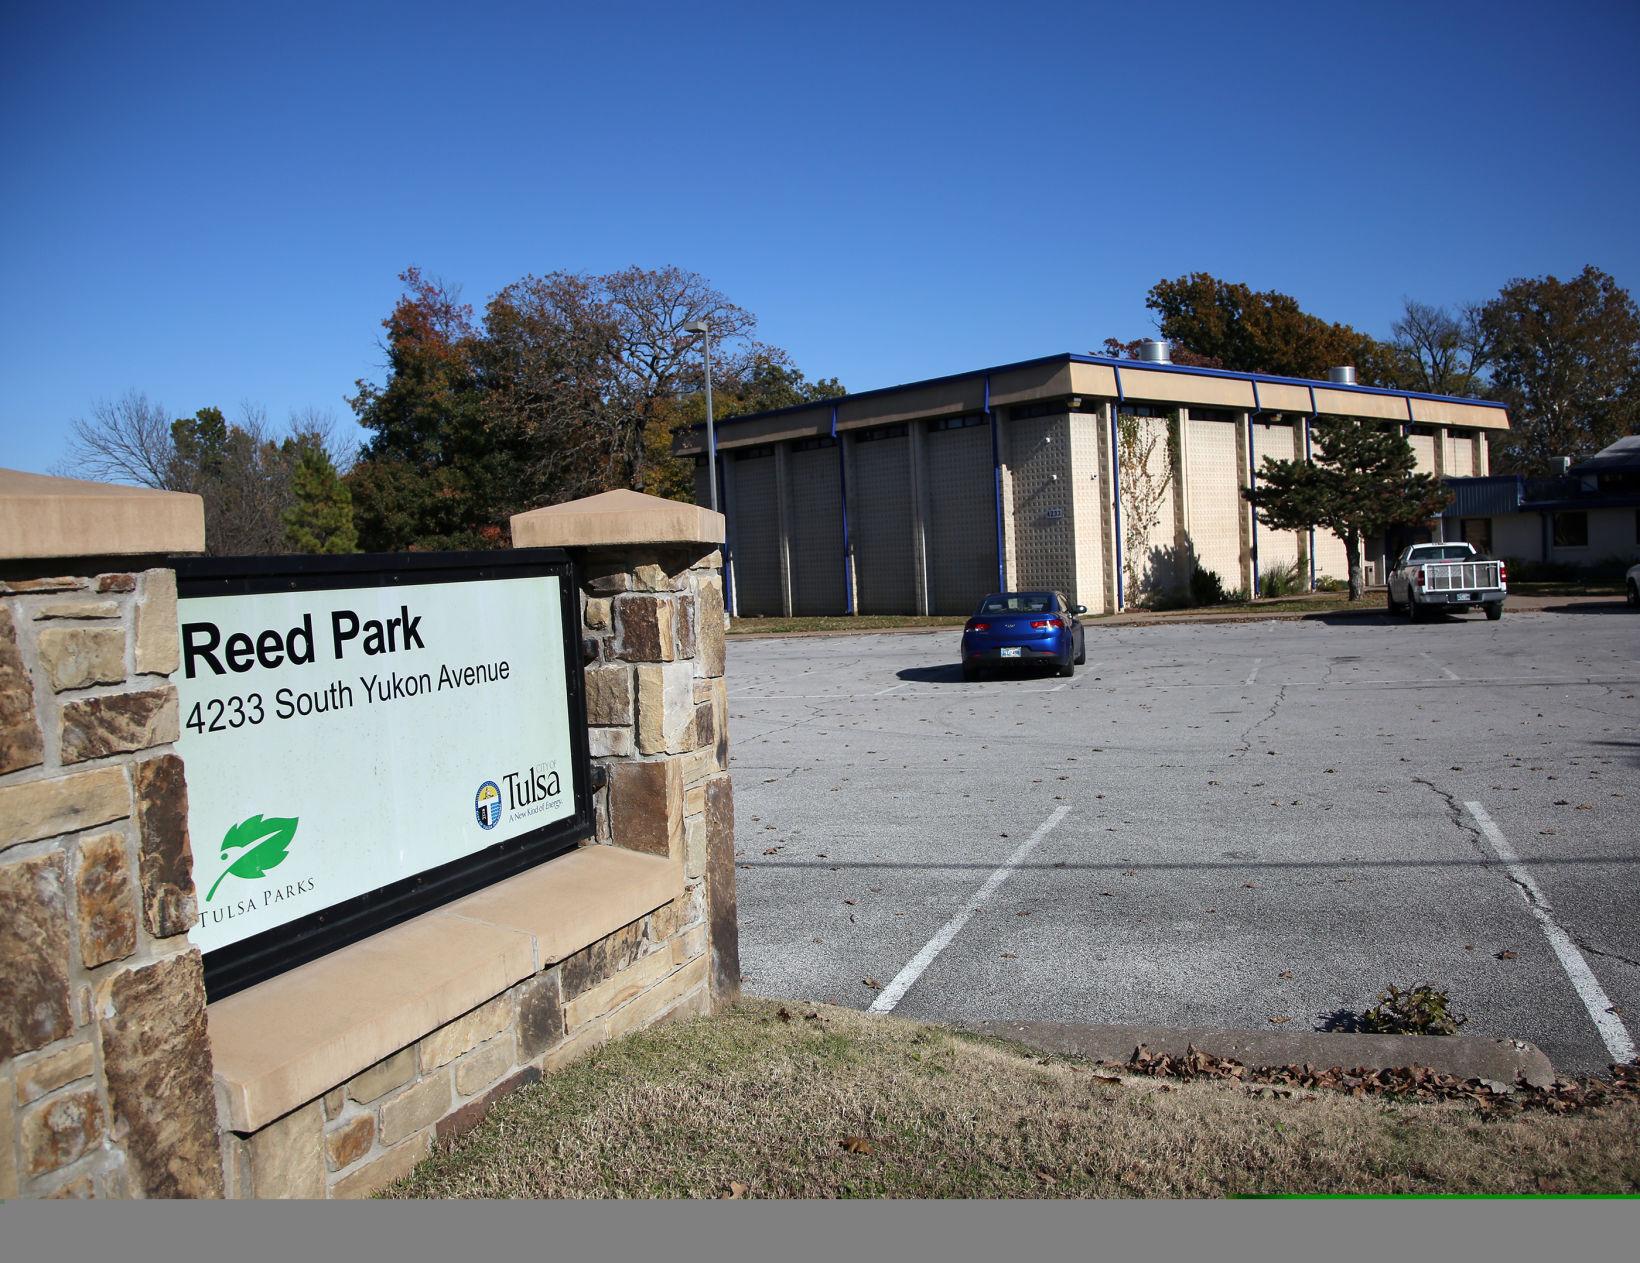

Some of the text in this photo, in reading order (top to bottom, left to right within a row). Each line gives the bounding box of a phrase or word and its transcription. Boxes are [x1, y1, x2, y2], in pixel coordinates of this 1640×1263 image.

[181, 605, 425, 679] Reed Park
[186, 660, 510, 734] 4233 South Yukon Avenue
[502, 766, 561, 810] Tulsa
[514, 811, 527, 821] New
[198, 877, 315, 928] TULSA PARKS
